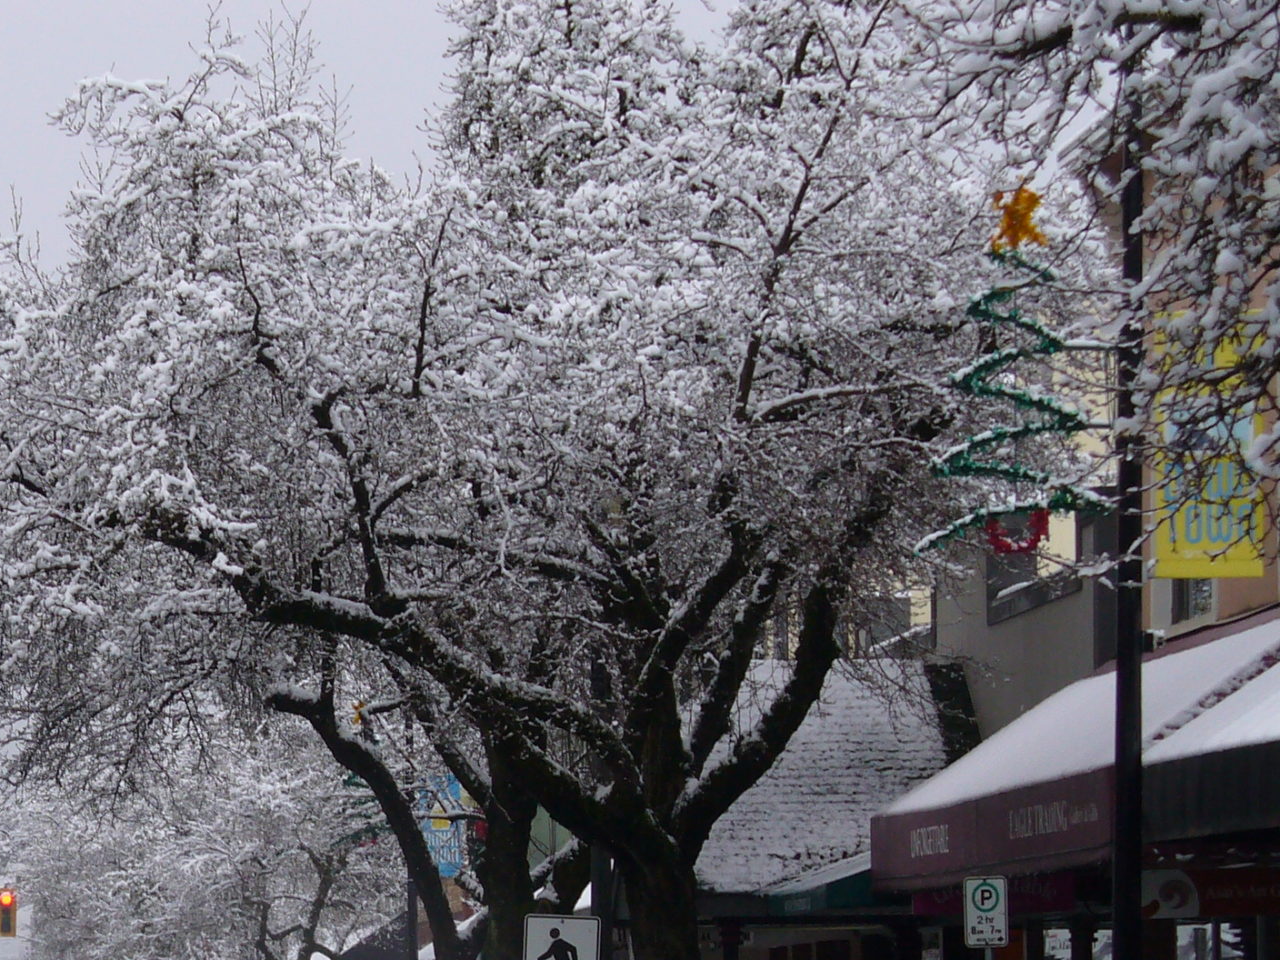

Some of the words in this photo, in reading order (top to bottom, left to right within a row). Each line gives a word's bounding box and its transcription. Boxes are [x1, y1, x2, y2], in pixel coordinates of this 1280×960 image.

[980, 889, 993, 906] P
[976, 916, 984, 925] 2
[985, 915, 994, 925] hr
